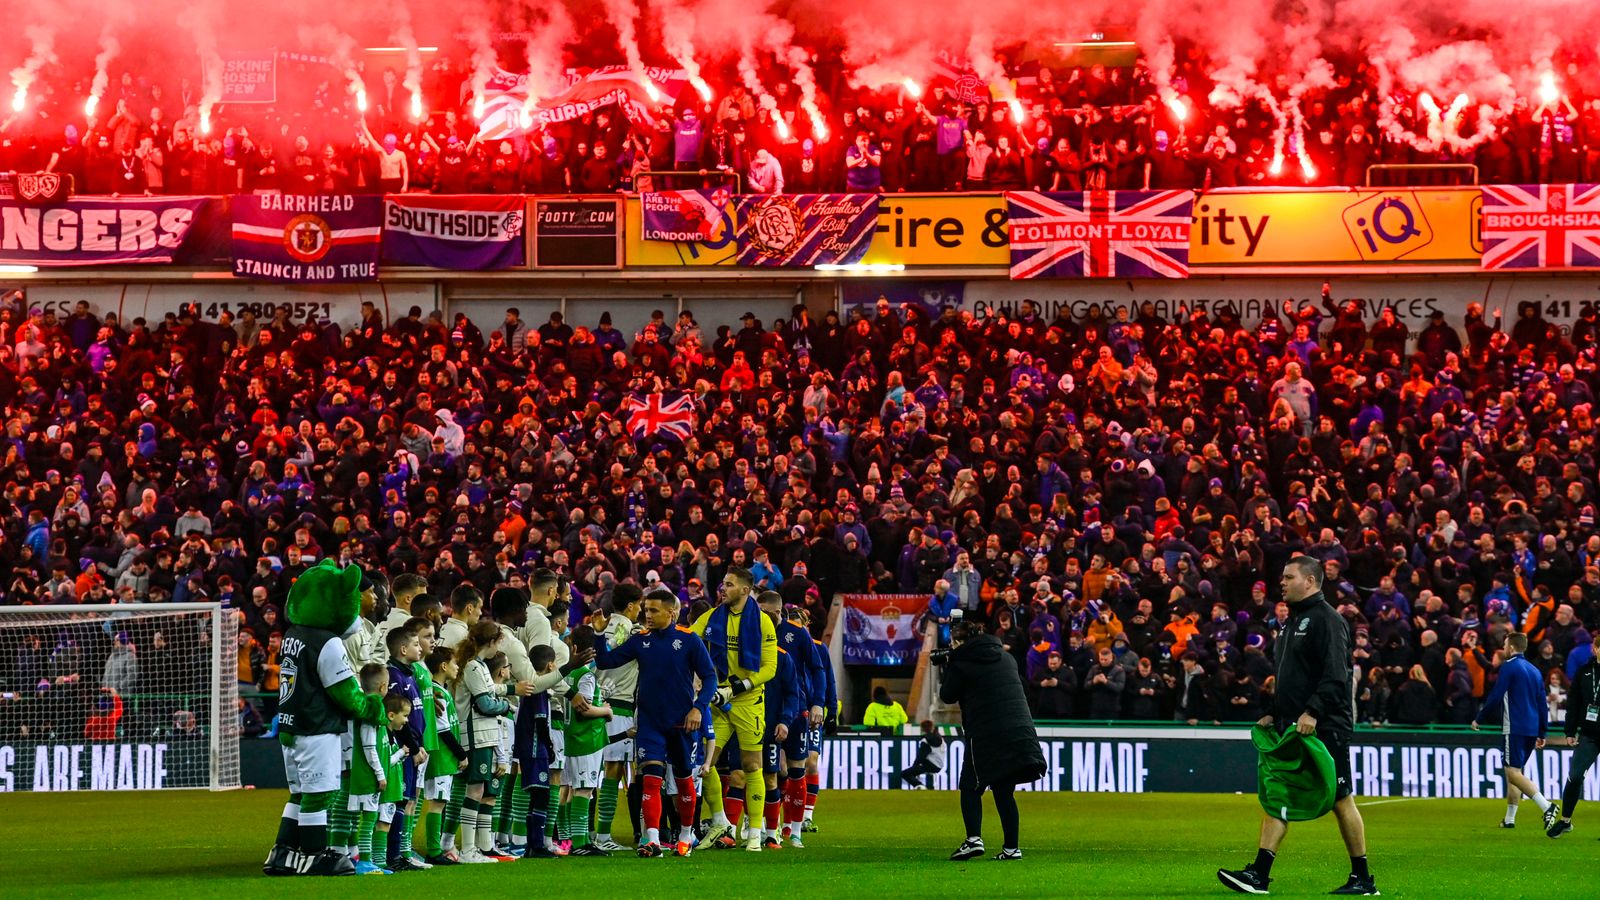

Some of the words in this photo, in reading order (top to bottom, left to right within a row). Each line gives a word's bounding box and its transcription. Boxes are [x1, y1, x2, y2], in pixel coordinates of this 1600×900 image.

[216, 60, 272, 72] SKINE
[216, 72, 266, 83] HOSEN
[225, 83, 256, 94] FEW
[261, 194, 354, 212] BARRHEAD
[645, 196, 663, 204] ARE
[645, 203, 681, 212] PEOPLE
[810, 201, 861, 216] Hamilton
[388, 204, 500, 238] SOUTHSIDE
[537, 211, 576, 223] FOOTY
[820, 215, 849, 237] Billy
[981, 208, 1008, 248] &
[1013, 225, 1116, 241] POLMONT
[1121, 225, 1188, 241] LOYAL
[1192, 204, 1270, 257] ity
[1357, 199, 1421, 253] iQ
[820, 237, 850, 254] Boys
[236, 259, 301, 279] STAUNCH
[306, 266, 336, 279] AND
[340, 262, 375, 278] TRUE
[280, 637, 306, 658] PERSY
[690, 742, 698, 757] 2
